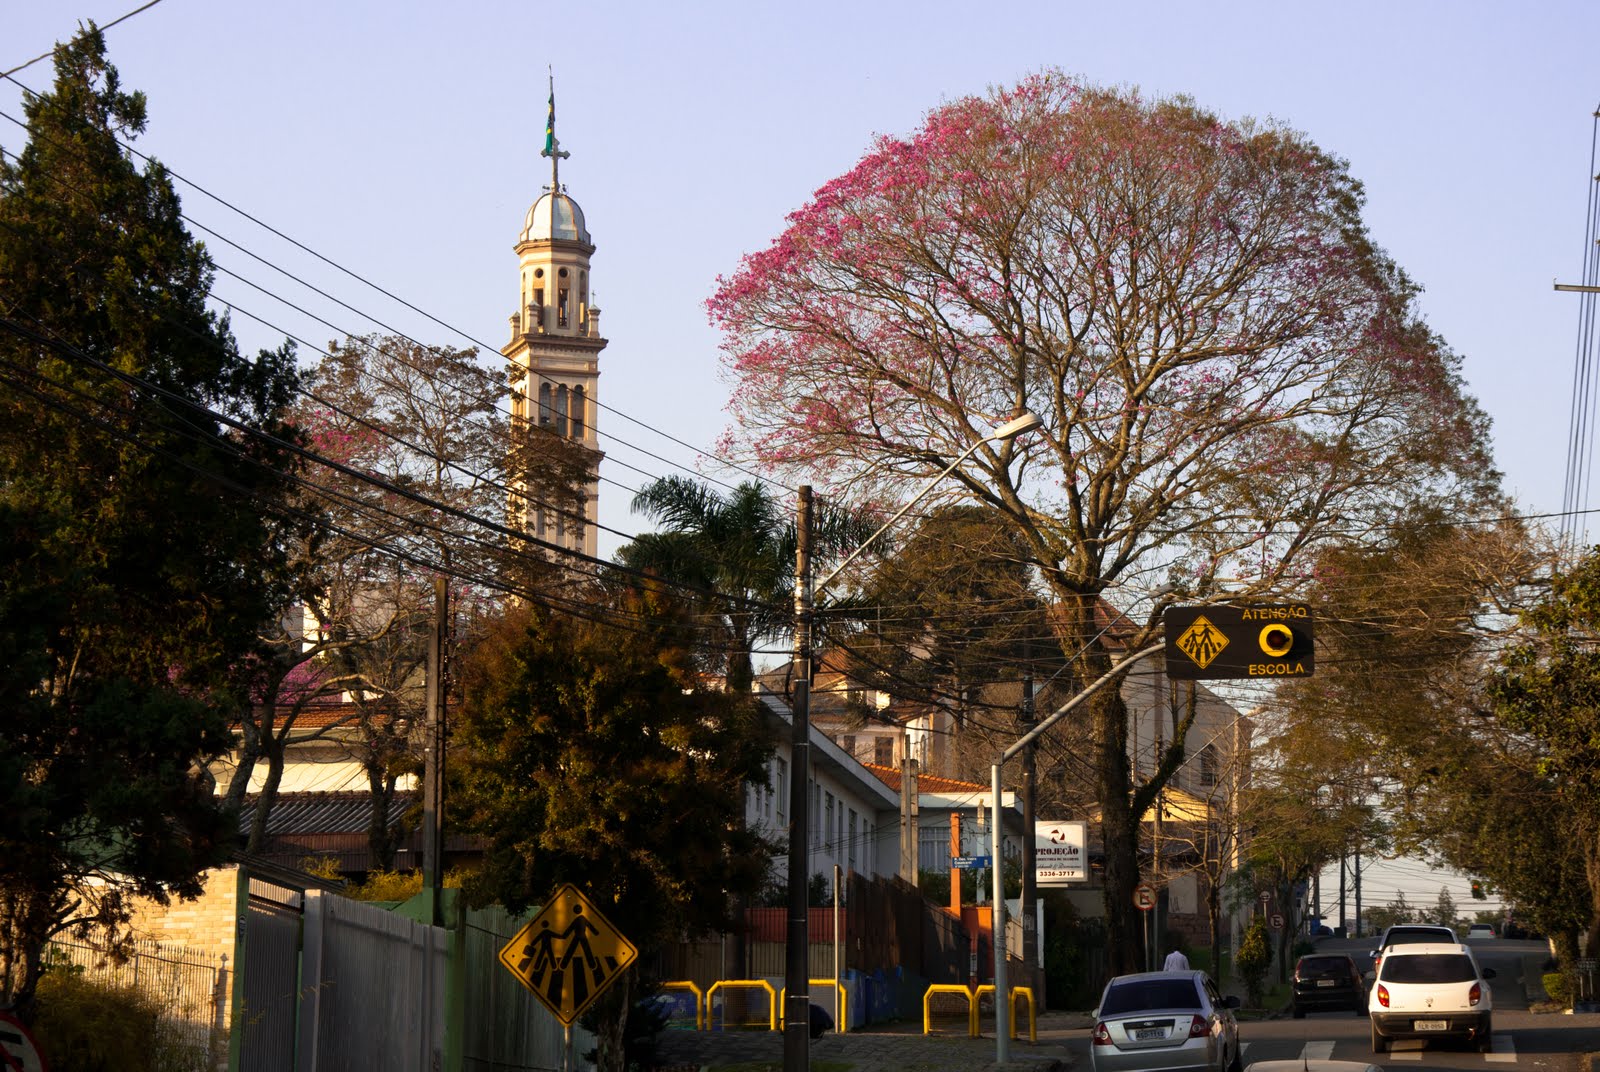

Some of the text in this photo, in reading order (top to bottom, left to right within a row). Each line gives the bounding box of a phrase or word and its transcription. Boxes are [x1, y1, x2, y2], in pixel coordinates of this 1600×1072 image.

[1242, 605, 1307, 620] ATENÇÃO
[1248, 663, 1305, 675] ESCOLA
[1036, 846, 1079, 856] PROJEÇÃO
